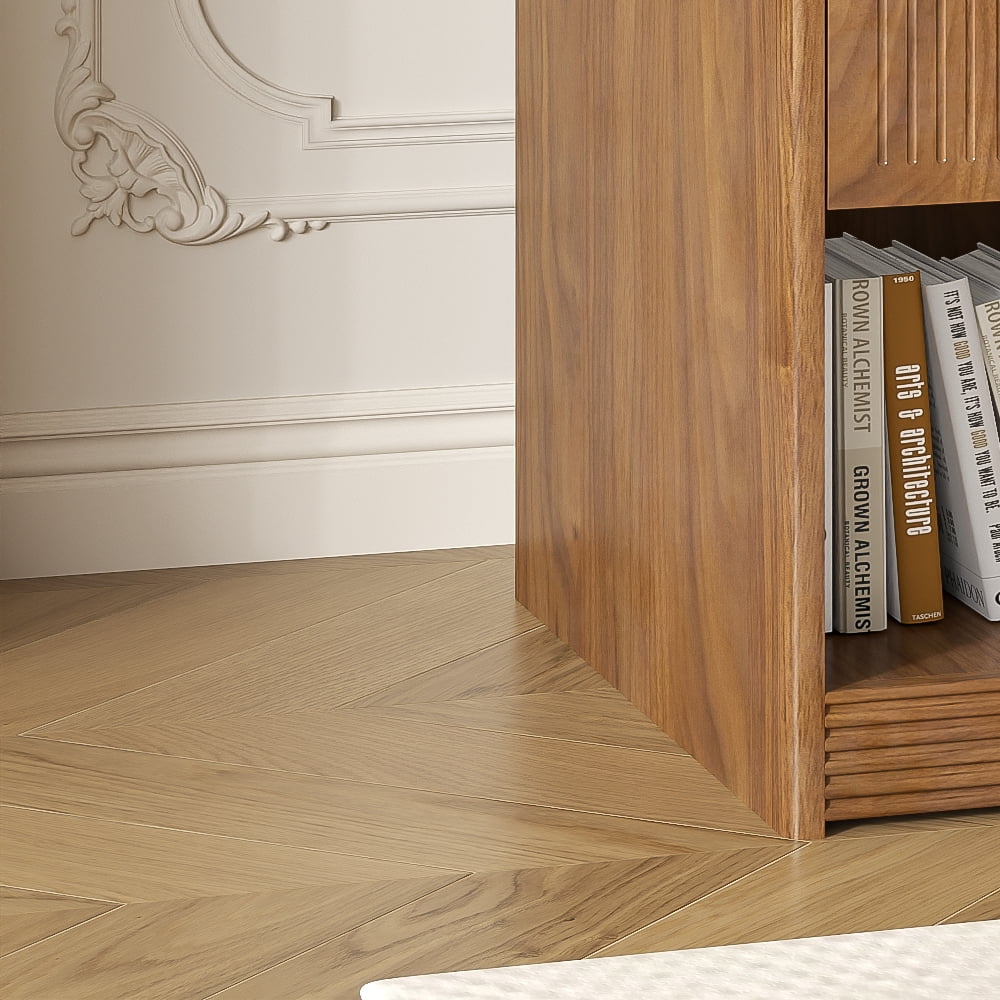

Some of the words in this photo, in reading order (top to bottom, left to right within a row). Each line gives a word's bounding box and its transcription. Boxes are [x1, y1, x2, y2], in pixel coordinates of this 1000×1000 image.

[893, 275, 915, 284] 1950
[943, 289, 961, 306] IT'S
[946, 305, 964, 321] NOT
[949, 321, 967, 339] HOW
[953, 340, 971, 360] GOOD
[957, 360, 975, 377] YOU
[852, 338, 871, 433] ALCHEMIST
[895, 363, 925, 400] arts
[960, 377, 978, 396] ARE,
[964, 395, 981, 411] IT'S
[897, 408, 924, 420] &
[967, 411, 984, 429] HOW
[970, 429, 988, 449] GOOD
[974, 449, 992, 466] YOU
[900, 427, 933, 536] architecture
[977, 466, 996, 487] WANT
[853, 465, 870, 533] GROWN
[982, 487, 998, 499] TO
[984, 499, 1000, 514] BE.
[854, 539, 872, 632] ALCHEMIS
[911, 611, 942, 621] TASCHEN
